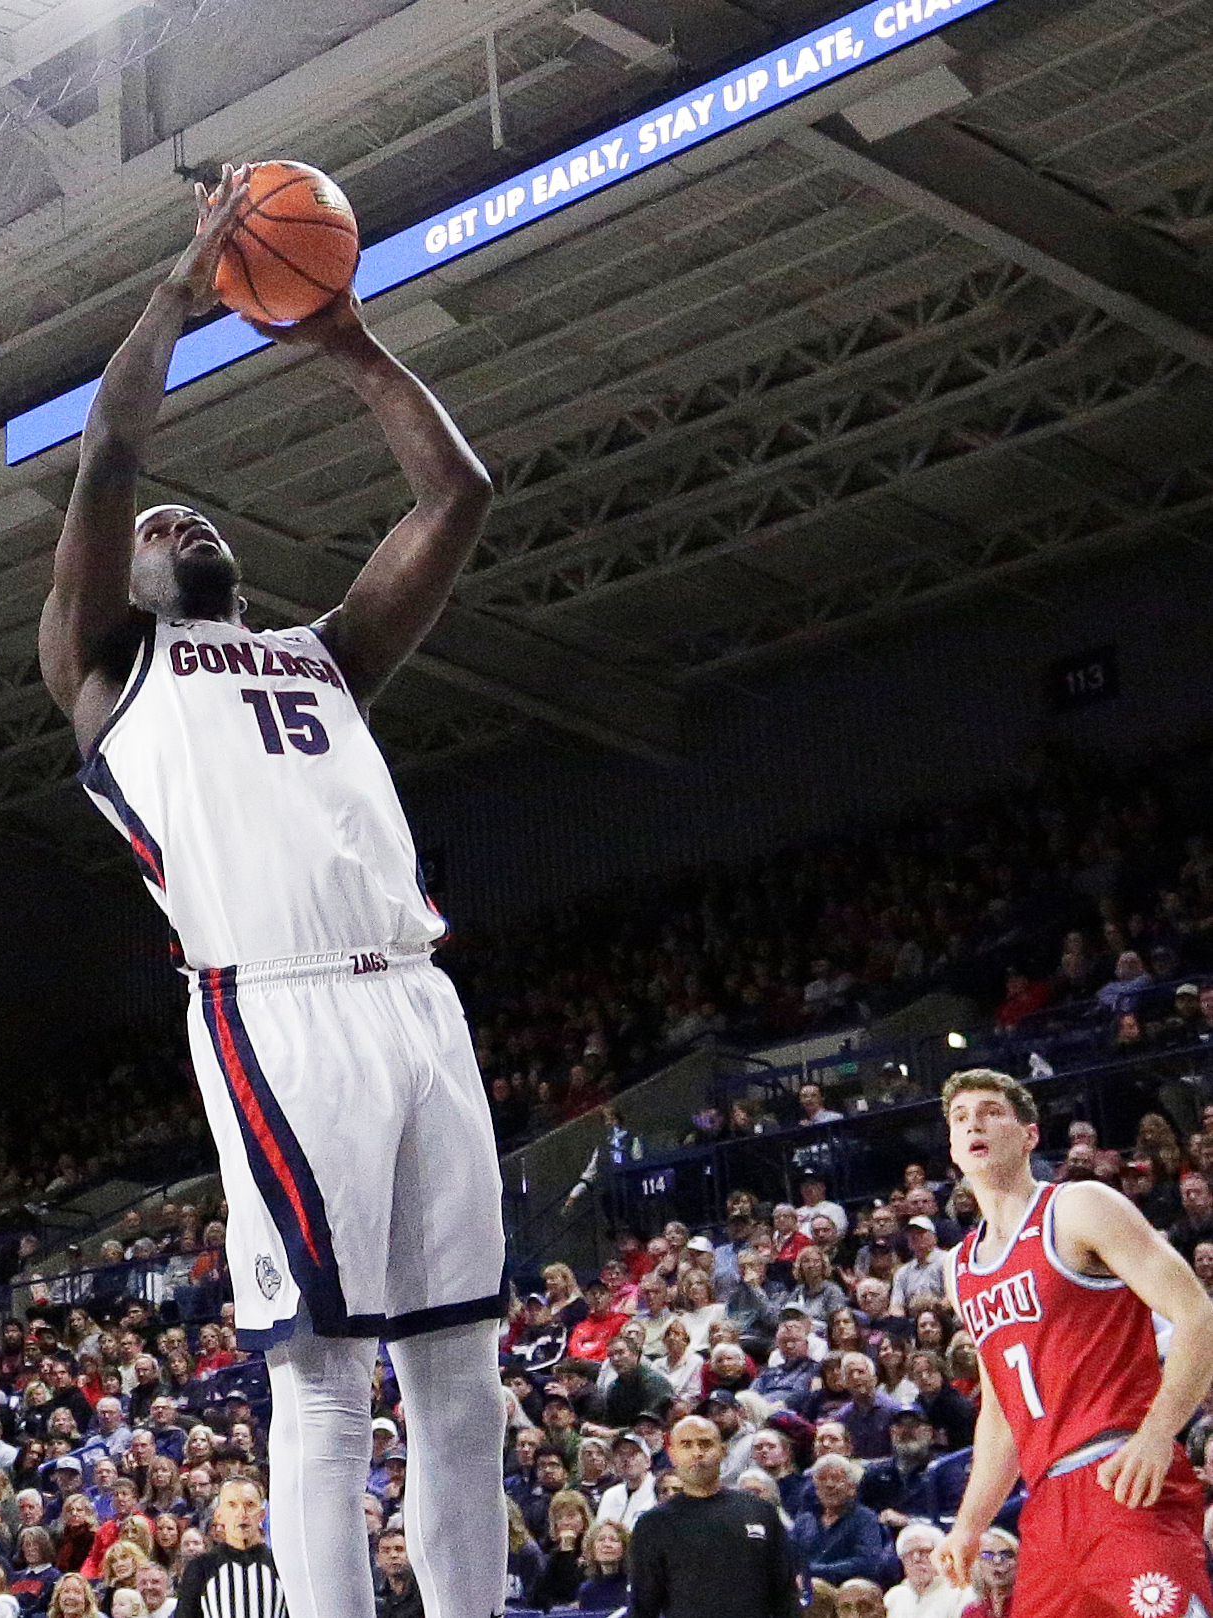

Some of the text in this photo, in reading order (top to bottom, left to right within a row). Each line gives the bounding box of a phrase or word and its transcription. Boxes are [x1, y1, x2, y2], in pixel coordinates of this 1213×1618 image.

[424, 207, 479, 254] GET
[484, 181, 525, 226] UP
[531, 138, 631, 205] EARLY,
[638, 96, 714, 154] STAY
[723, 69, 769, 114] UP
[777, 33, 865, 89] LATE,
[241, 688, 331, 755] 15
[349, 952, 389, 975] ZAGS
[642, 1176, 666, 1195] 114
[962, 1269, 1043, 1347] LMU
[1003, 1342, 1045, 1419] 1
